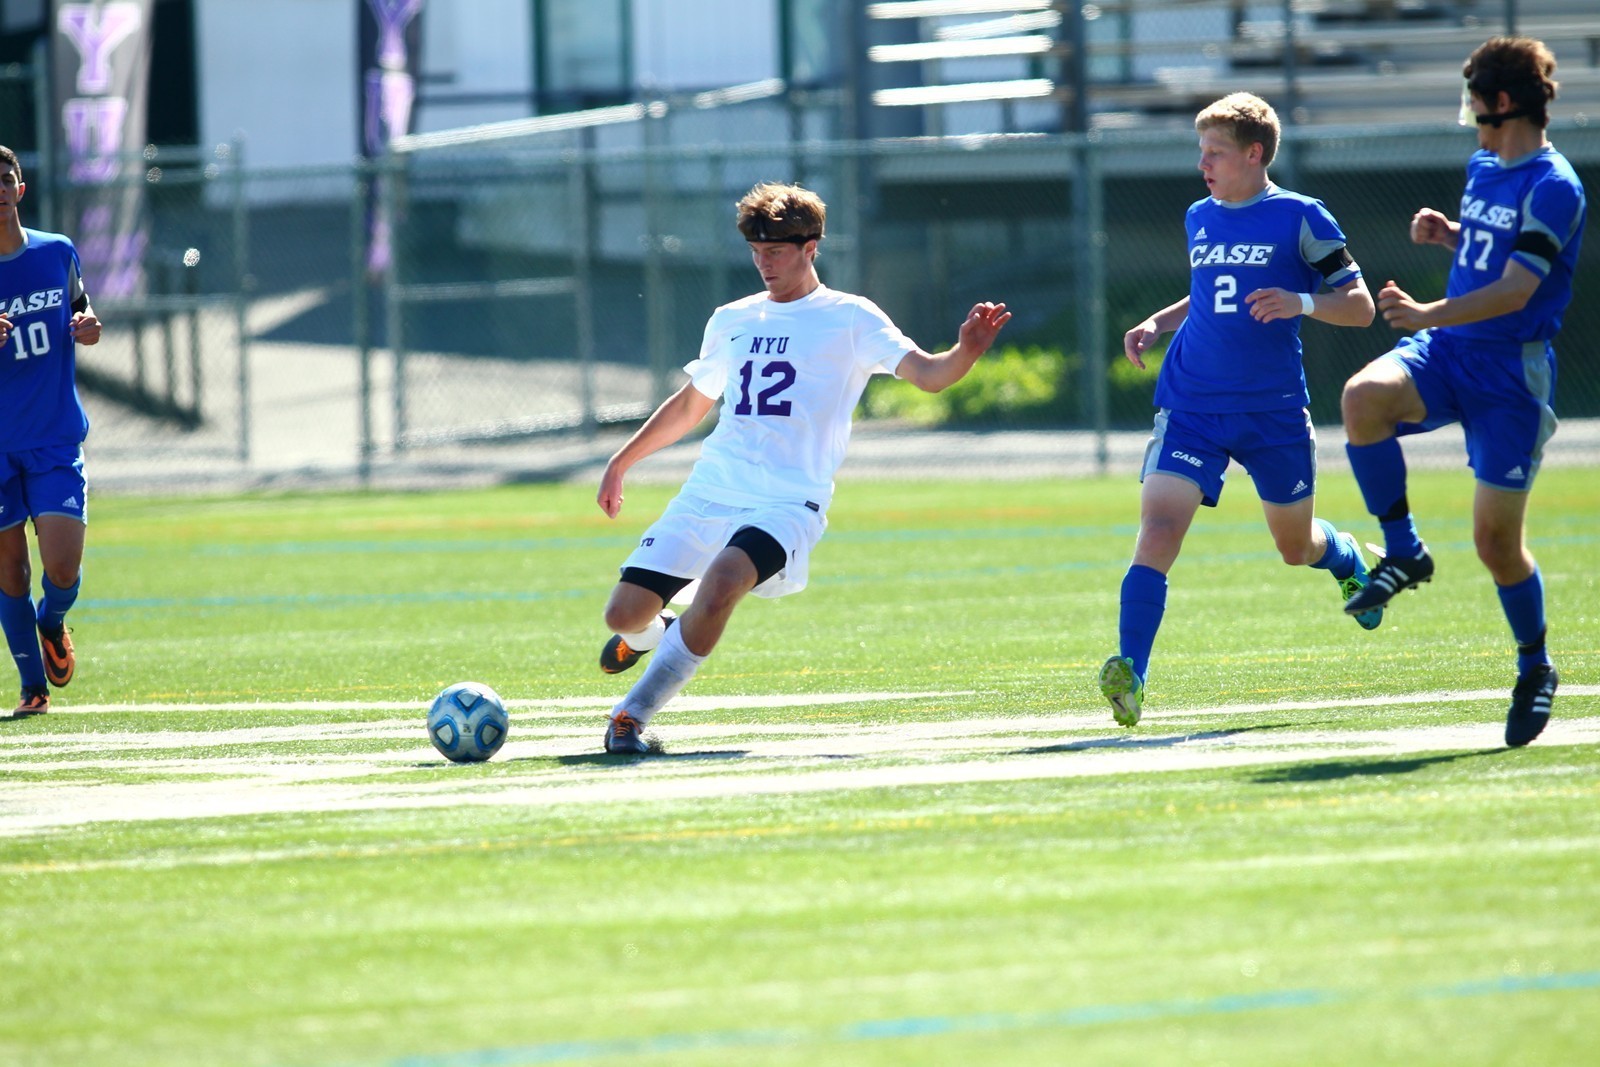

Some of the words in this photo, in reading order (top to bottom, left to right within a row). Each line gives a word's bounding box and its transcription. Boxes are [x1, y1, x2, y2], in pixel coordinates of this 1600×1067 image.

[1190, 244, 1273, 268] CASE
[1458, 226, 1494, 271] 17
[1214, 275, 1237, 313] 2
[11, 321, 51, 360] 10
[749, 336, 790, 354] NYU
[734, 360, 797, 417] 12
[1171, 450, 1204, 468] CASE
